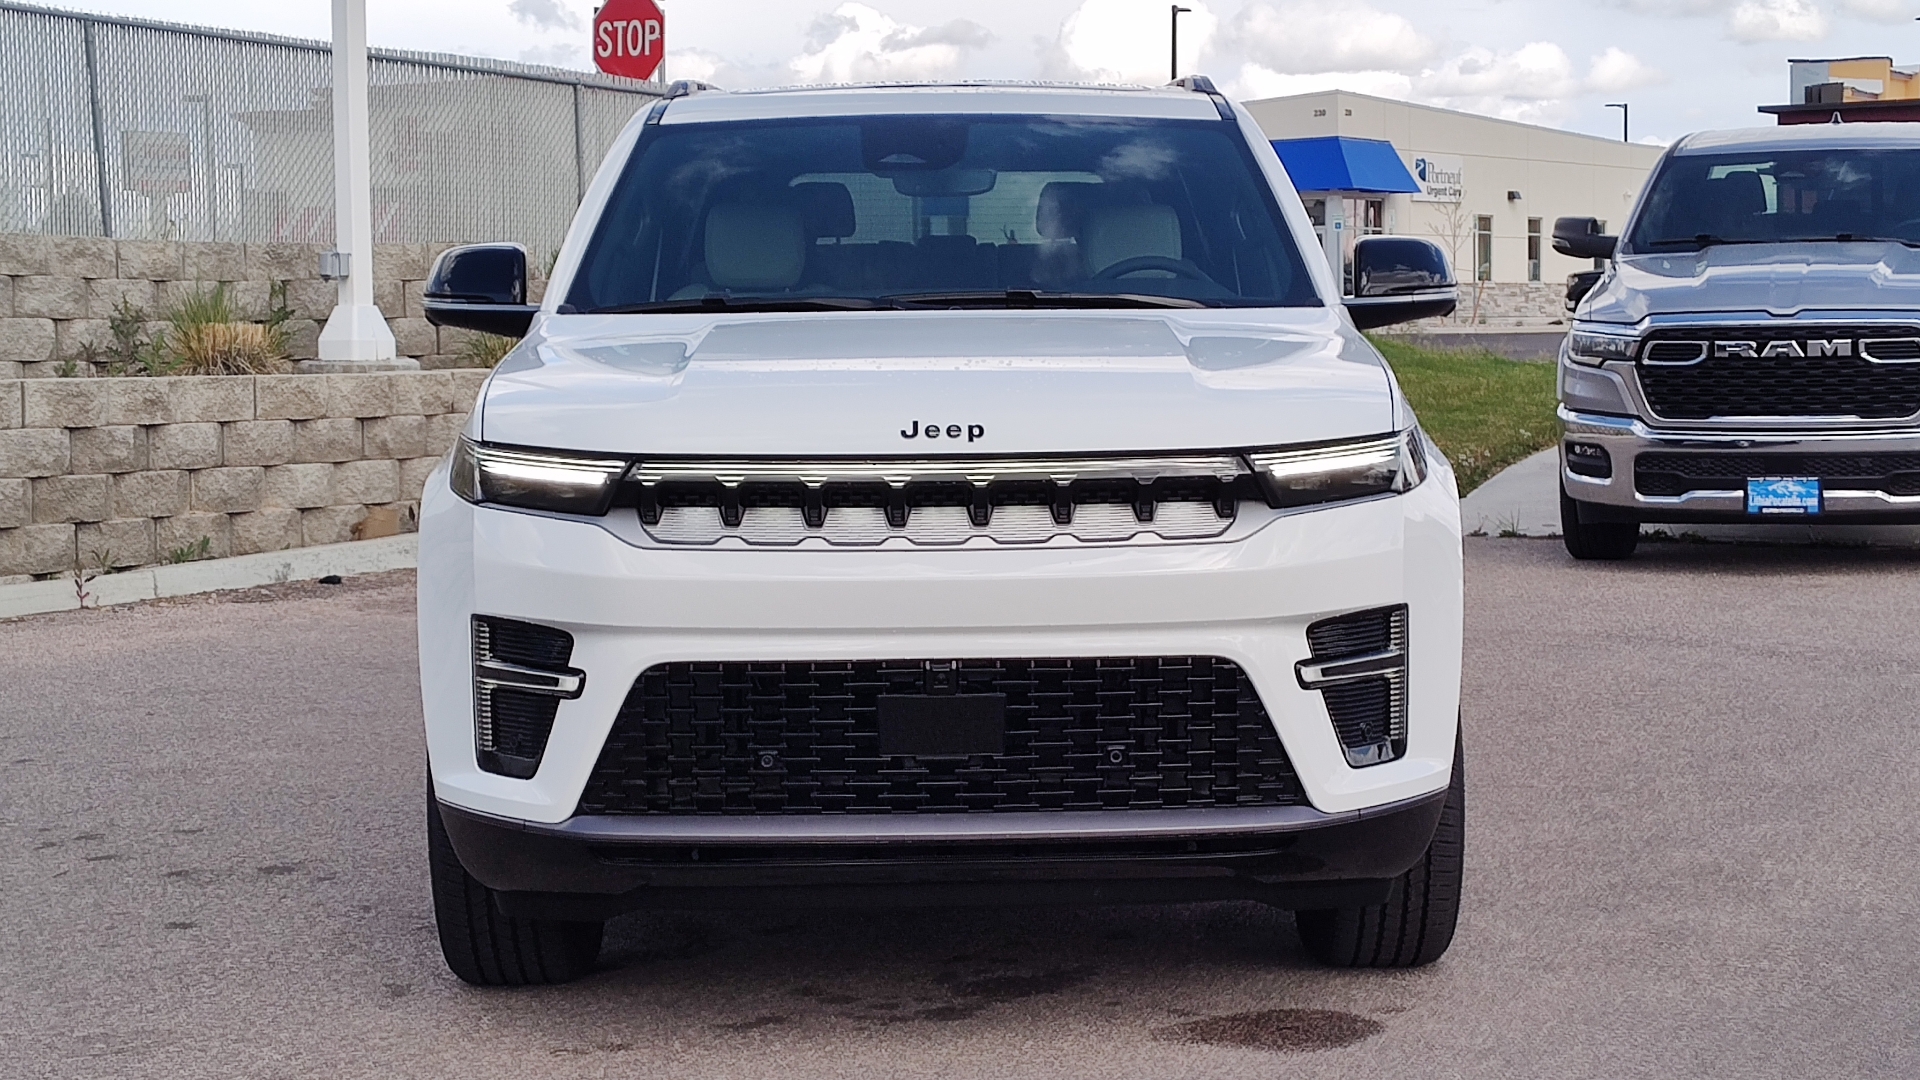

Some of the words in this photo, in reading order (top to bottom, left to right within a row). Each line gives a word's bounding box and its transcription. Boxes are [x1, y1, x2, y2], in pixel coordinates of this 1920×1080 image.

[597, 19, 661, 58] STOP
[1427, 185, 1447, 198] Urgent
[1714, 339, 1852, 358] RAM
[900, 420, 985, 443] Jeep
